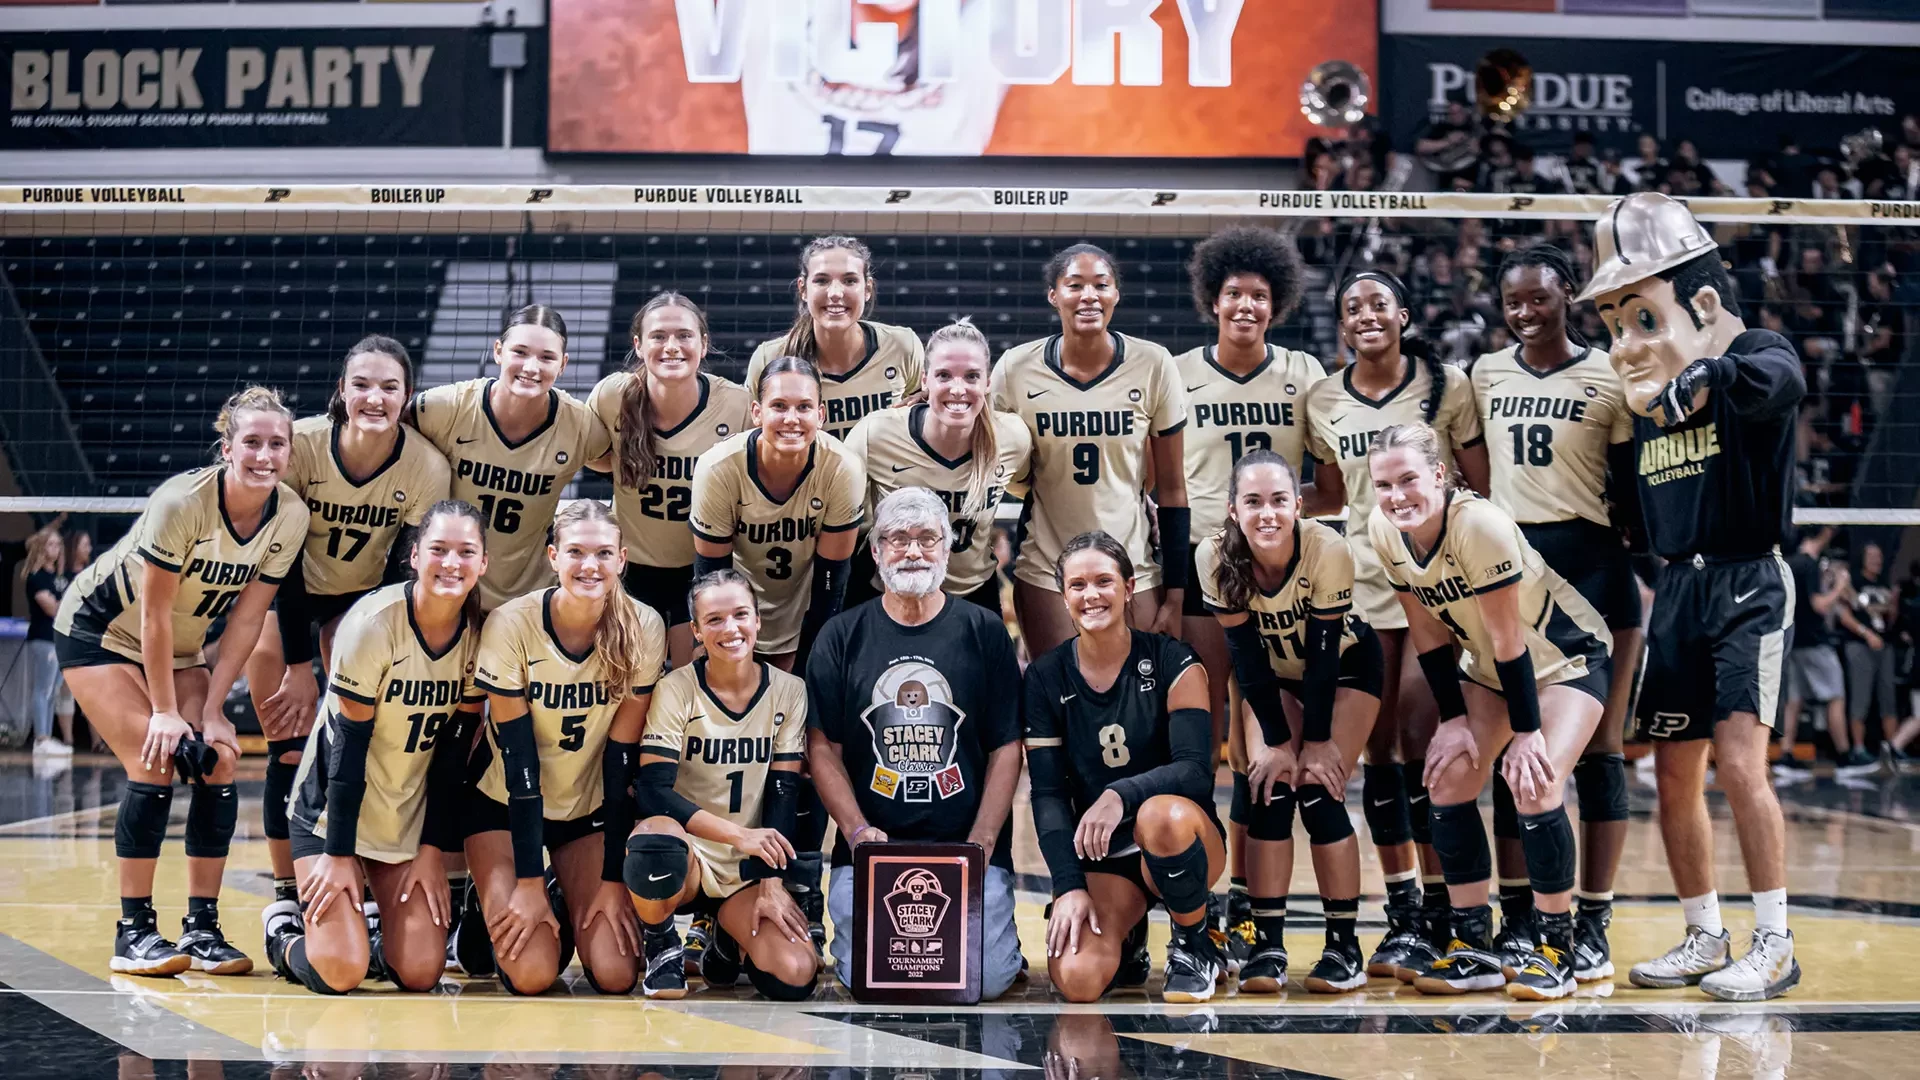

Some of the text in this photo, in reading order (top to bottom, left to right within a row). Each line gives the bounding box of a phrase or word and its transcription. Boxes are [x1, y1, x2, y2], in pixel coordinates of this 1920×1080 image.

[11, 45, 434, 110] BLOCK PARTY
[1685, 87, 1895, 116] College of Liberal Arts
[11, 113, 33, 128] THE
[821, 114, 900, 156] 17
[22, 187, 185, 202] PURDUE VOLLEYBALL
[371, 188, 445, 203] BOILER UP
[634, 188, 802, 204] PURDUE VOLLEYBALL
[994, 190, 1069, 205] BOILER UP
[1259, 193, 1427, 209] PURDUE VOLLEYBALL
[1871, 203, 1920, 218] PURDU
[1035, 410, 1134, 437] PURDUE
[1194, 402, 1295, 428] PURDUE
[1489, 396, 1588, 423] PURDUE
[1508, 424, 1553, 467] 18
[456, 457, 556, 496] PURDUE
[1072, 442, 1100, 485] 9
[308, 497, 400, 528] PURDUE
[477, 493, 524, 534] 16
[638, 483, 692, 522] 22
[327, 525, 371, 562] 17
[735, 516, 818, 544] PURDUE
[185, 557, 257, 586] PURDU
[765, 546, 793, 580] 3
[192, 589, 241, 619] 10
[385, 679, 465, 707] PURDU
[529, 681, 609, 709] PURDU
[404, 712, 448, 754] 19
[559, 715, 588, 752] 5
[883, 726, 945, 746] STACEY
[1098, 723, 1131, 768] 8
[686, 736, 772, 765] PURDU
[888, 744, 941, 763] CLARK
[897, 759, 936, 773] Classic
[726, 770, 744, 814] 1
[898, 905, 935, 916] STACEY
[901, 915, 932, 926] CLARK
[887, 957, 945, 965] TOURNAMENT
[891, 964, 940, 972] CHAMPIONS
